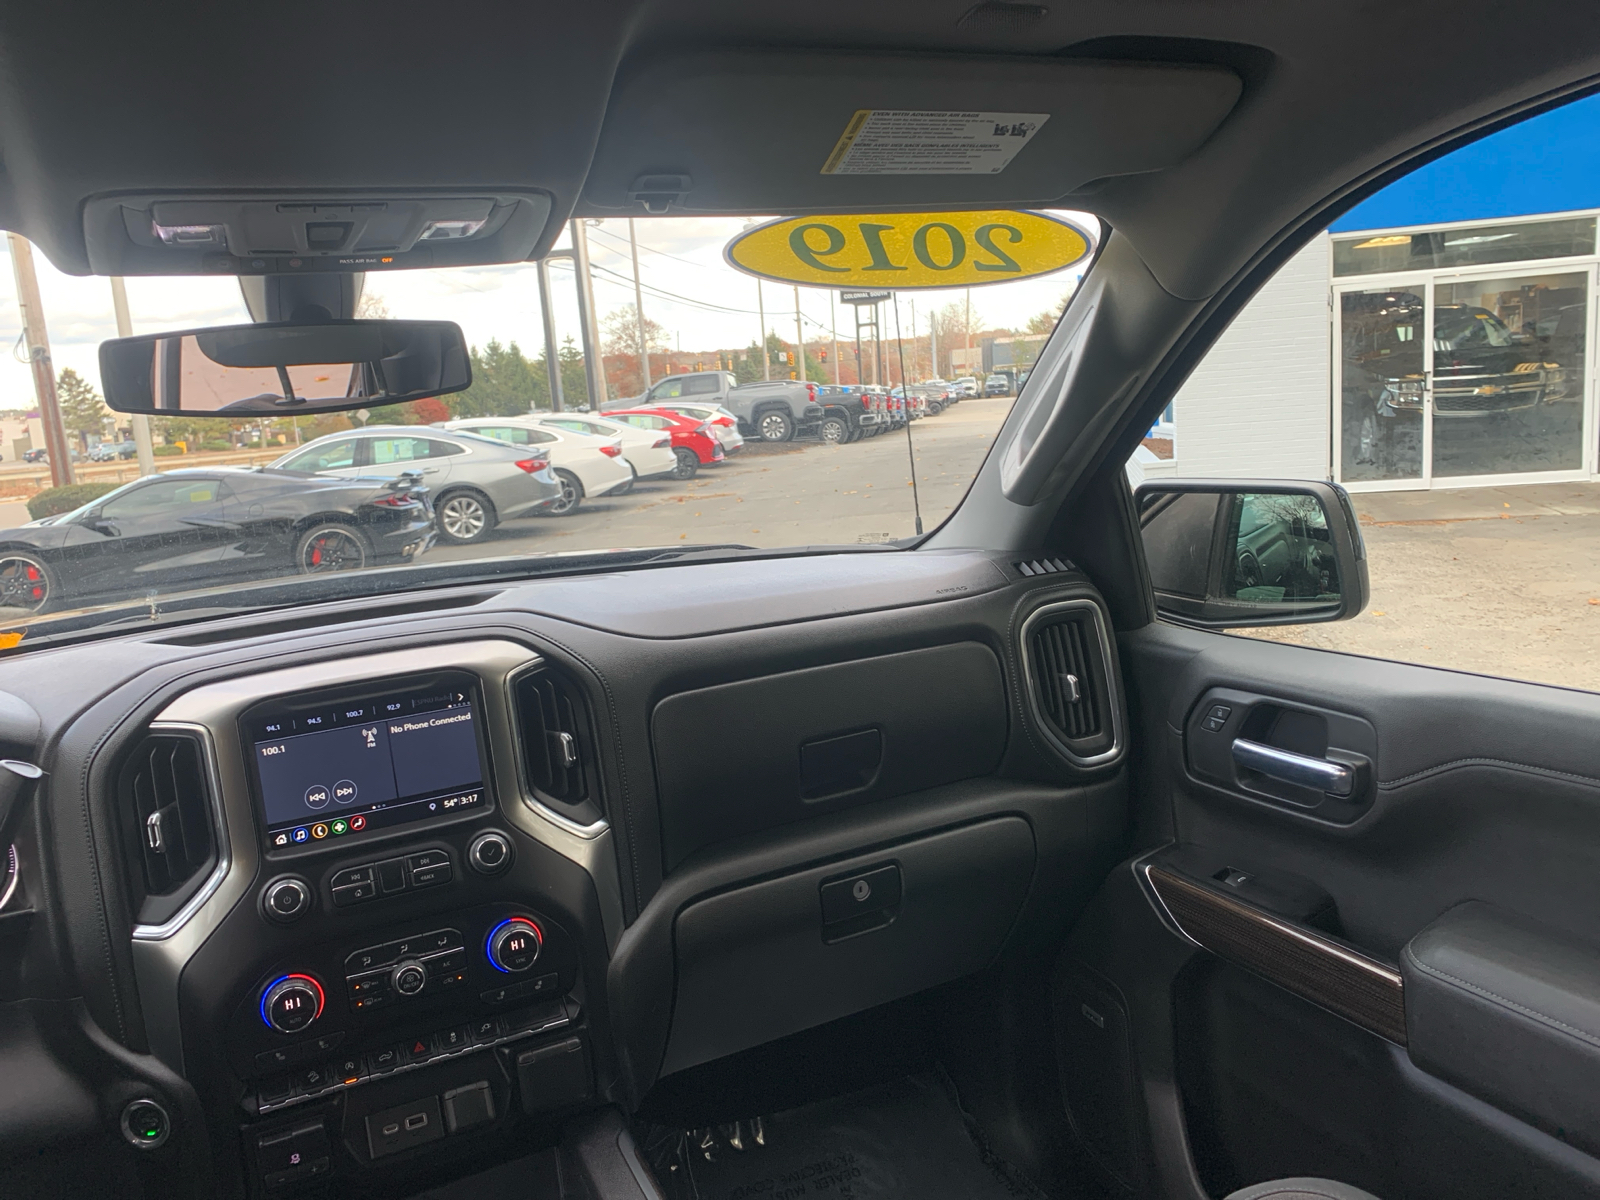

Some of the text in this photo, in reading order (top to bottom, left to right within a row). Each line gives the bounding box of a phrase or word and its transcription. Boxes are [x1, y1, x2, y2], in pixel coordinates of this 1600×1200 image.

[843, 292, 869, 300] COLONIAL
[935, 585, 968, 595] AIRBAG
[386, 703, 401, 711] 92.9
[345, 709, 364, 718] 100.7
[307, 716, 322, 725] 94.5
[390, 712, 472, 735] No Phone Connected
[266, 723, 281, 733] 94.1
[261, 745, 285, 756] 100.1
[443, 794, 478, 809] 54° 3:17
[510, 938, 525, 951] HI
[284, 997, 301, 1010] HI
